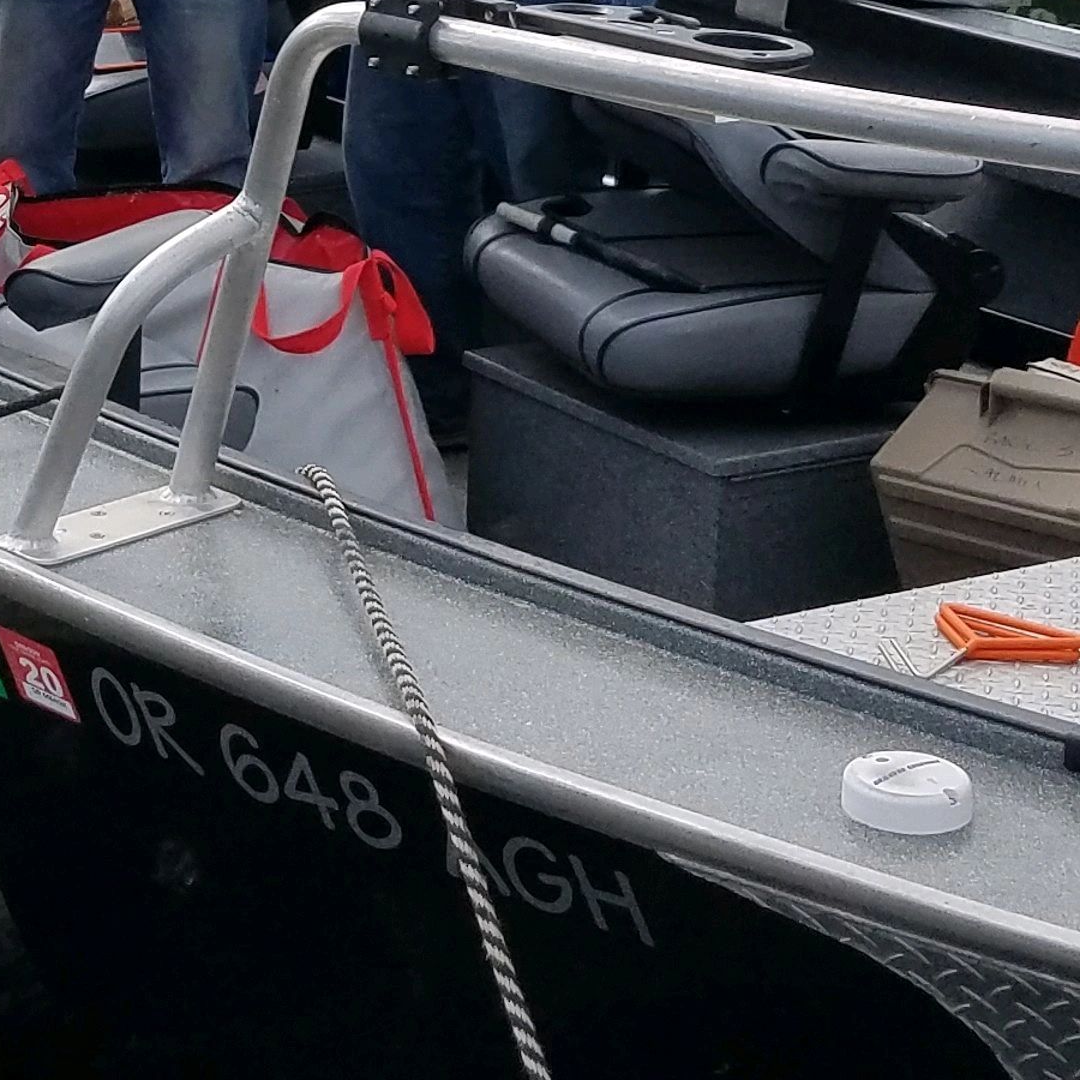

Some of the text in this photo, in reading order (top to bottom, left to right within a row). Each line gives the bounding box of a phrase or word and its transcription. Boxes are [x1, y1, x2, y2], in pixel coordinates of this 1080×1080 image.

[18, 656, 64, 698] 20
[91, 666, 205, 777] OR
[220, 722, 403, 850] 648
